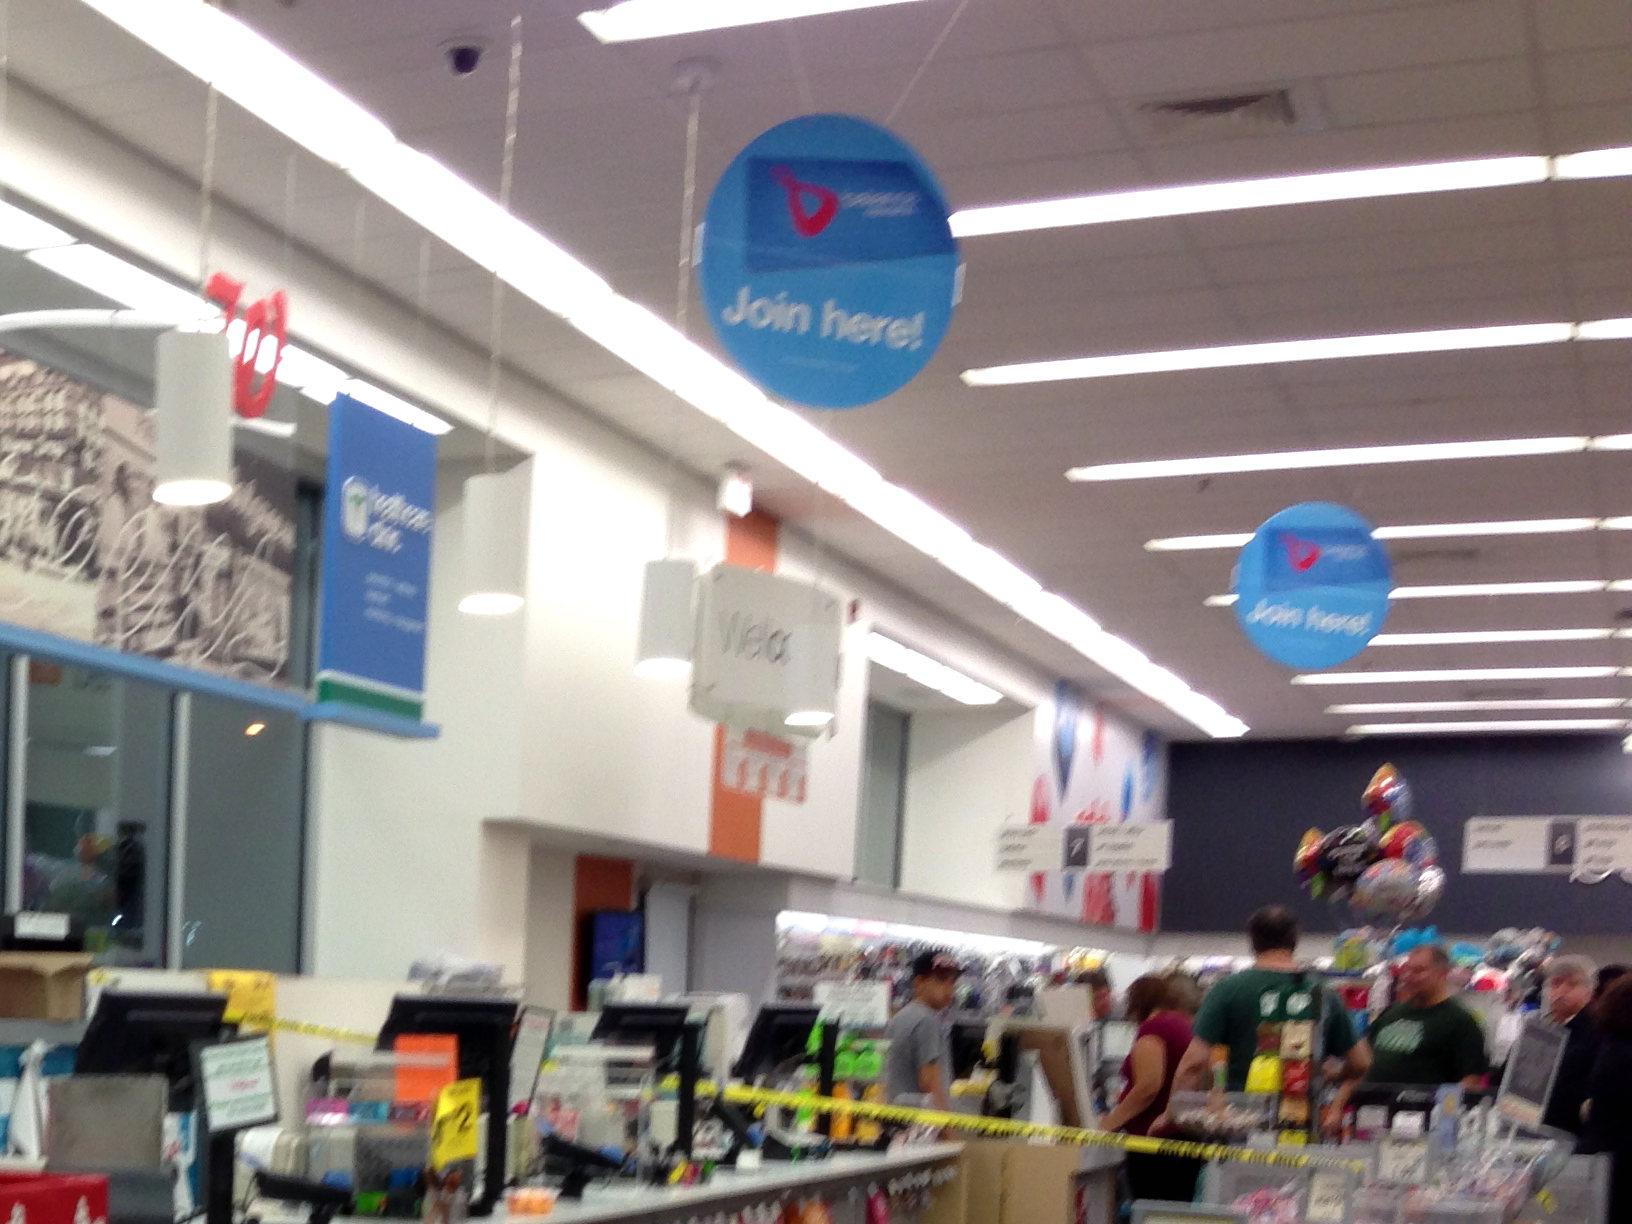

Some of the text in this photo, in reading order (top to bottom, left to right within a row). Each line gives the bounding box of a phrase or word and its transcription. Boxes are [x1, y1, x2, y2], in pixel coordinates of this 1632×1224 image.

[721, 286, 926, 352] Join here!
[1246, 598, 1374, 637] Join here!
